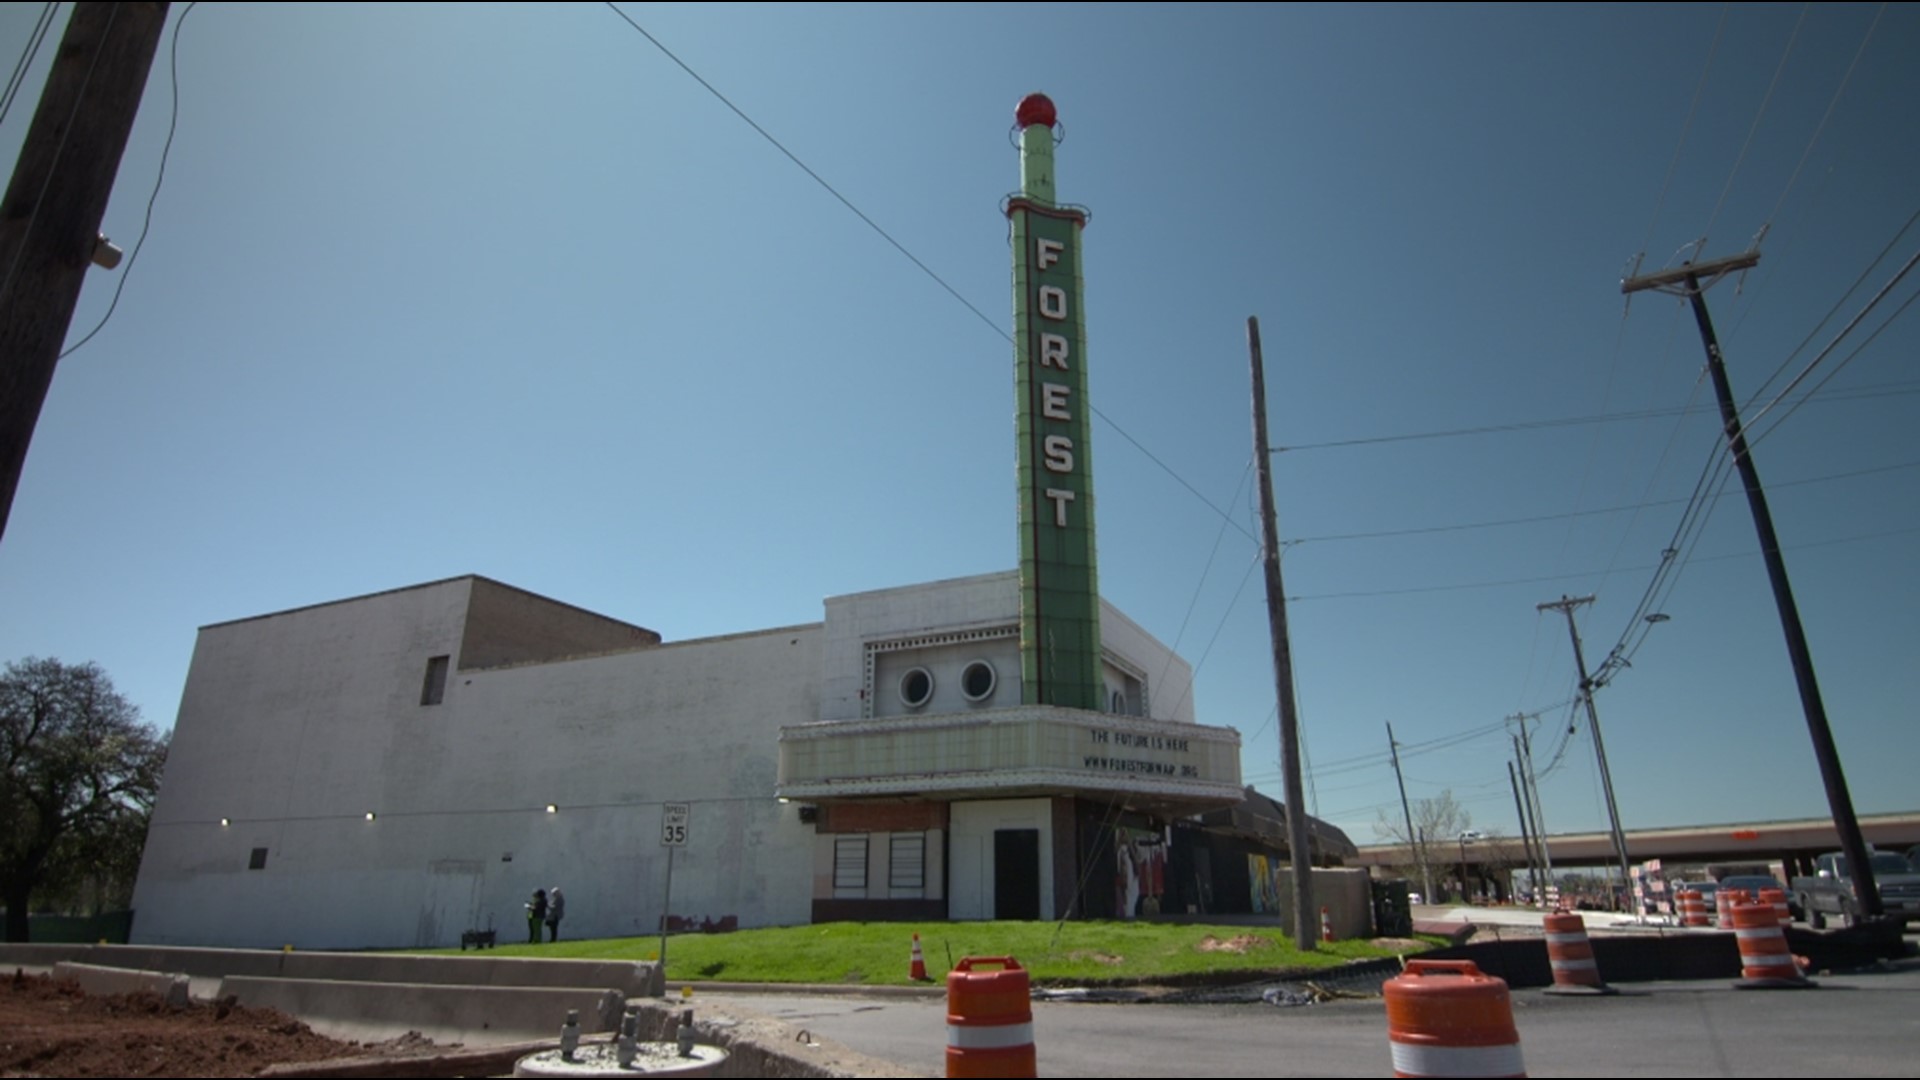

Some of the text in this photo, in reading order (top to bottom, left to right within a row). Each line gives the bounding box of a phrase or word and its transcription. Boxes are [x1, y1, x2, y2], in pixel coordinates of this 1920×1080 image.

[1036, 237, 1075, 527] FOREST
[1091, 729, 1189, 752] THE FUTURE IS HERE
[666, 805, 687, 814] SPEED
[667, 815, 685, 823] LIMIT
[664, 825, 685, 843] 35
